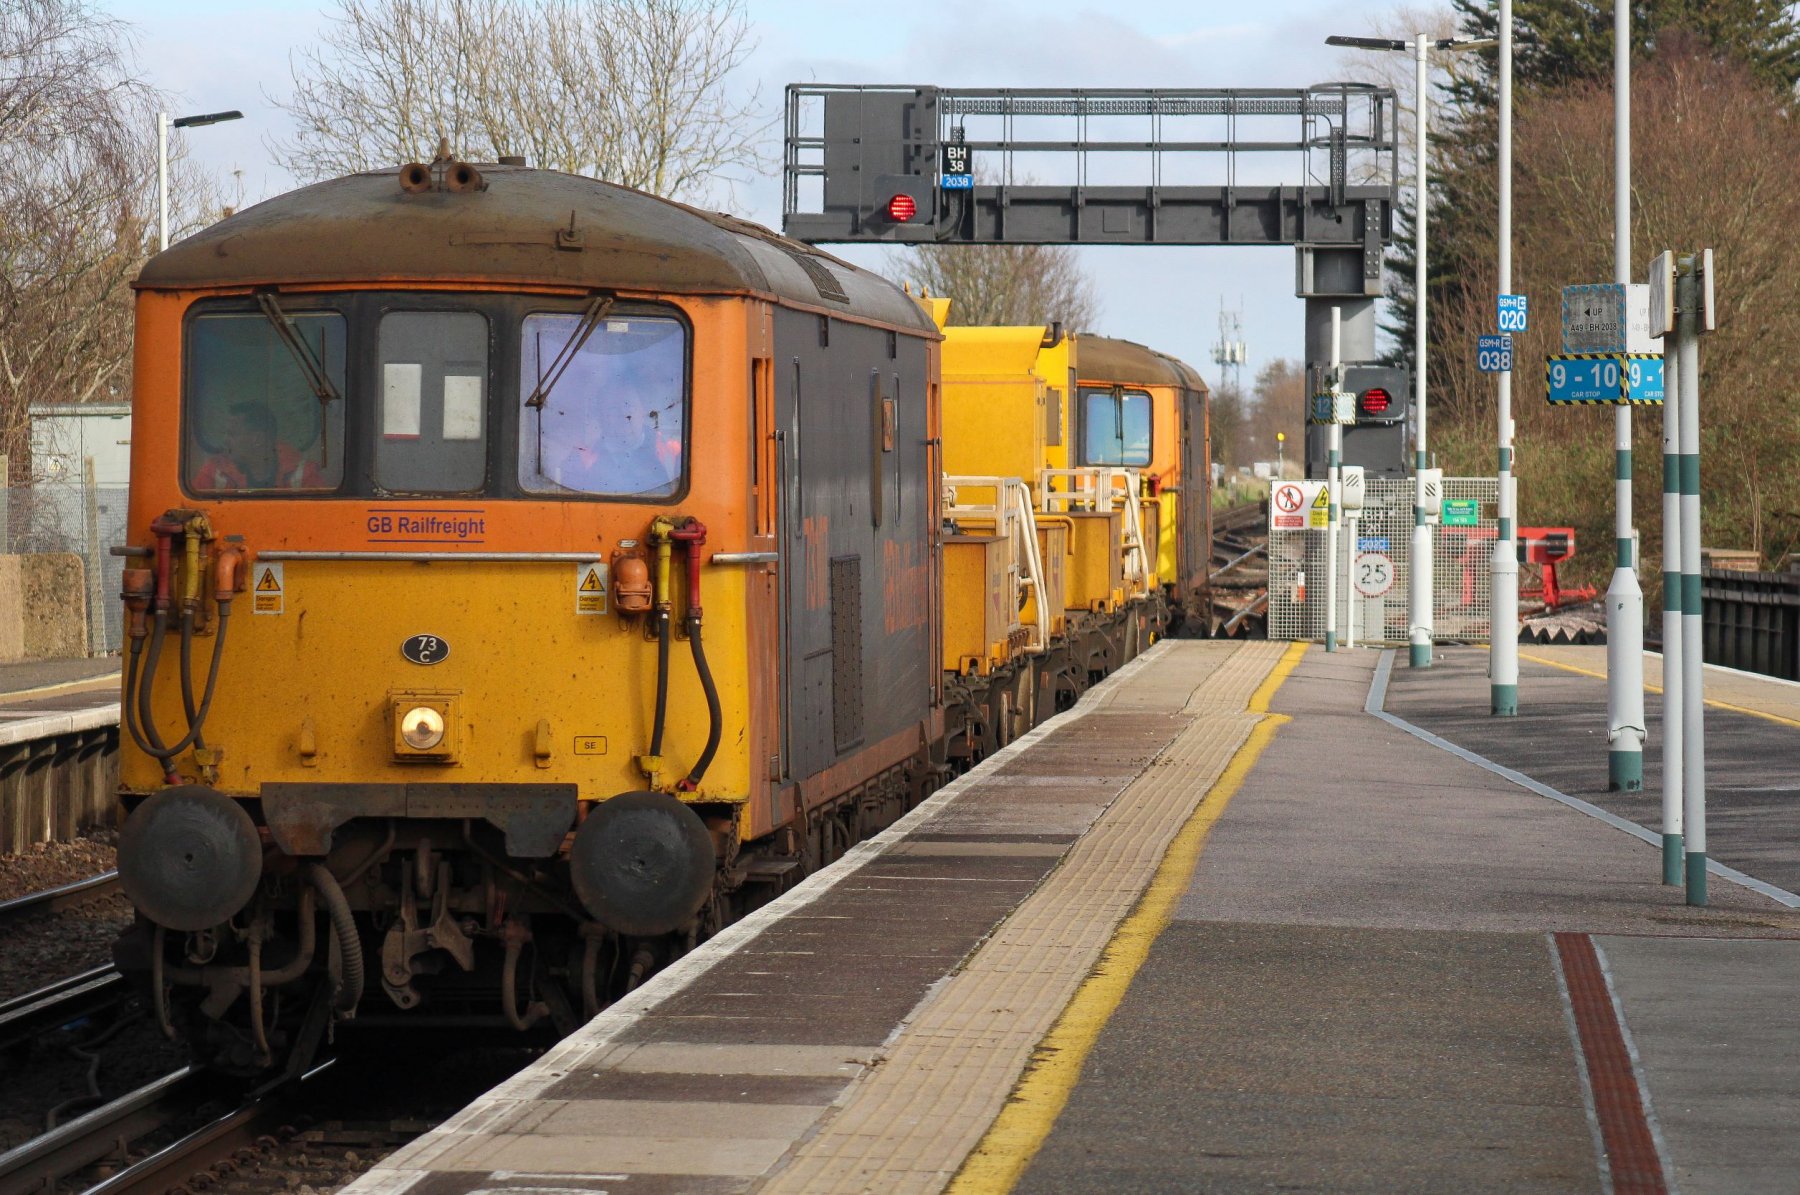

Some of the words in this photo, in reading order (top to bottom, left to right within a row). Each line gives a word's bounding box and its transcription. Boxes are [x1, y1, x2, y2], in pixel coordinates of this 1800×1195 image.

[947, 146, 967, 159] BH
[950, 160, 965, 172] 38
[945, 177, 969, 187] 2038
[1500, 298, 1517, 308] GSM-R
[1592, 308, 1603, 316] UP
[1500, 310, 1527, 330] 020
[1570, 324, 1584, 332] A49
[1589, 324, 1600, 332] BH
[1480, 339, 1500, 348] GSM-R
[1480, 351, 1511, 370] 038
[1553, 364, 1566, 389] 9
[1590, 363, 1618, 388] 10
[1630, 363, 1641, 388] 9
[367, 516, 392, 533] GB
[398, 516, 485, 538] Railfreight
[1361, 563, 1387, 584] 25
[418, 636, 438, 651] 73
[420, 650, 431, 662] C
[584, 741, 598, 750] SE
